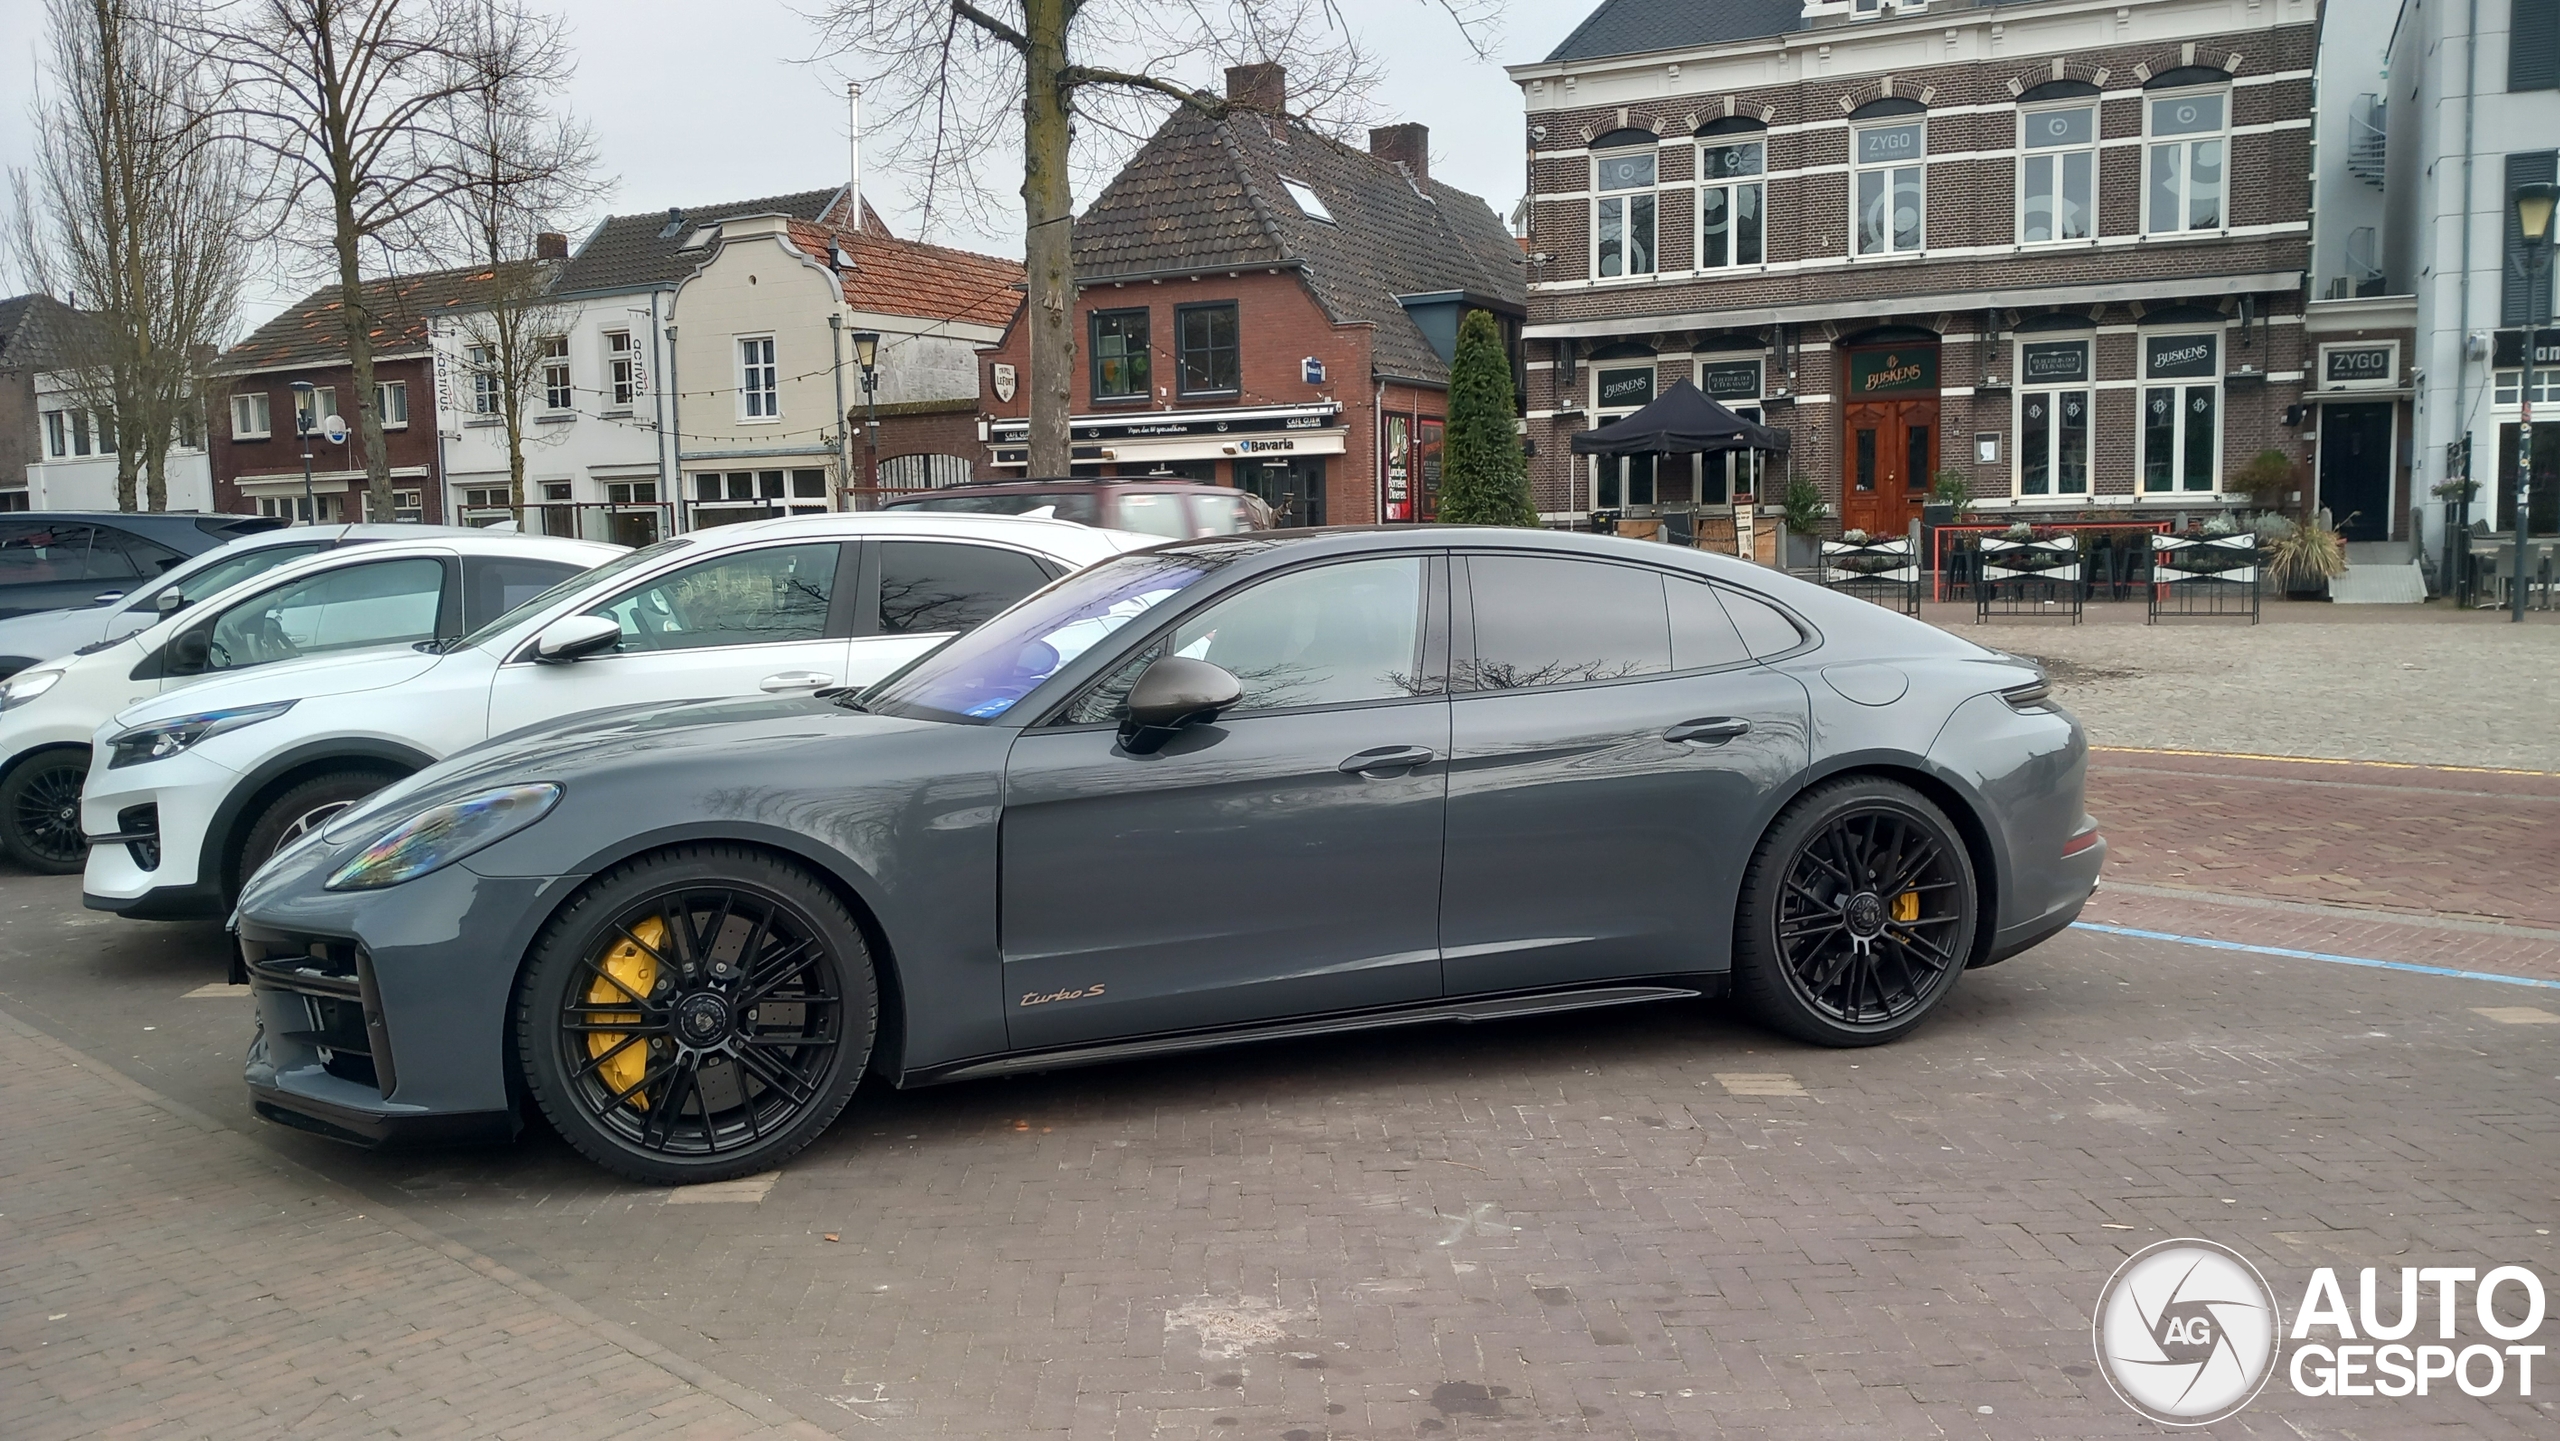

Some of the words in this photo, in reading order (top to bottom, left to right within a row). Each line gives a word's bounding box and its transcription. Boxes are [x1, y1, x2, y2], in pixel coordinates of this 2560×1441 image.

[1869, 133, 1910, 150] ZYGO
[2333, 352, 2384, 370] ZYGO
[1251, 438, 1294, 453] Bavaria
[1020, 987, 1083, 1006] turbo
[1083, 983, 1105, 997] S
